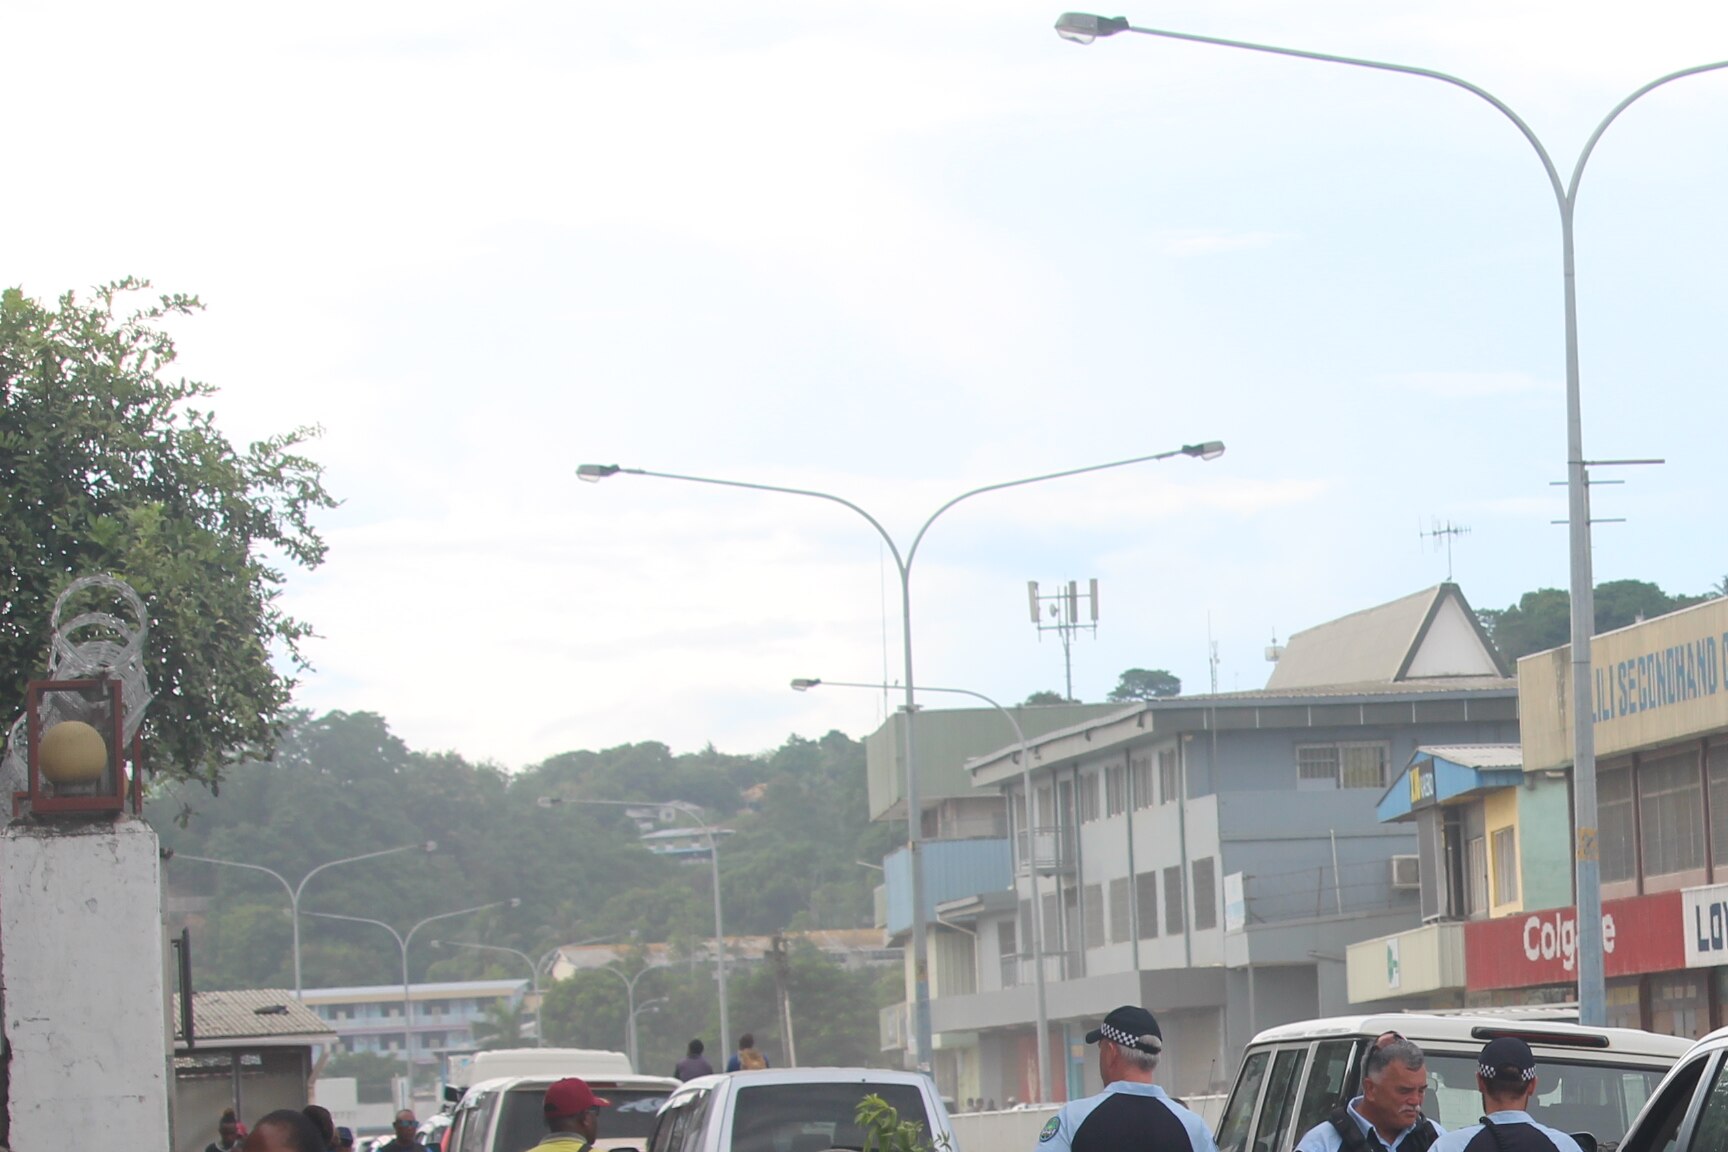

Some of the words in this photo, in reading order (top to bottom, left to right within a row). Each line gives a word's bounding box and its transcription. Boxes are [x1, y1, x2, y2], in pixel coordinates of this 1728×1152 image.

[1592, 664, 1615, 724] ILI
[1618, 635, 1718, 717] SECONDHAND
[1523, 912, 1616, 971] Colge
